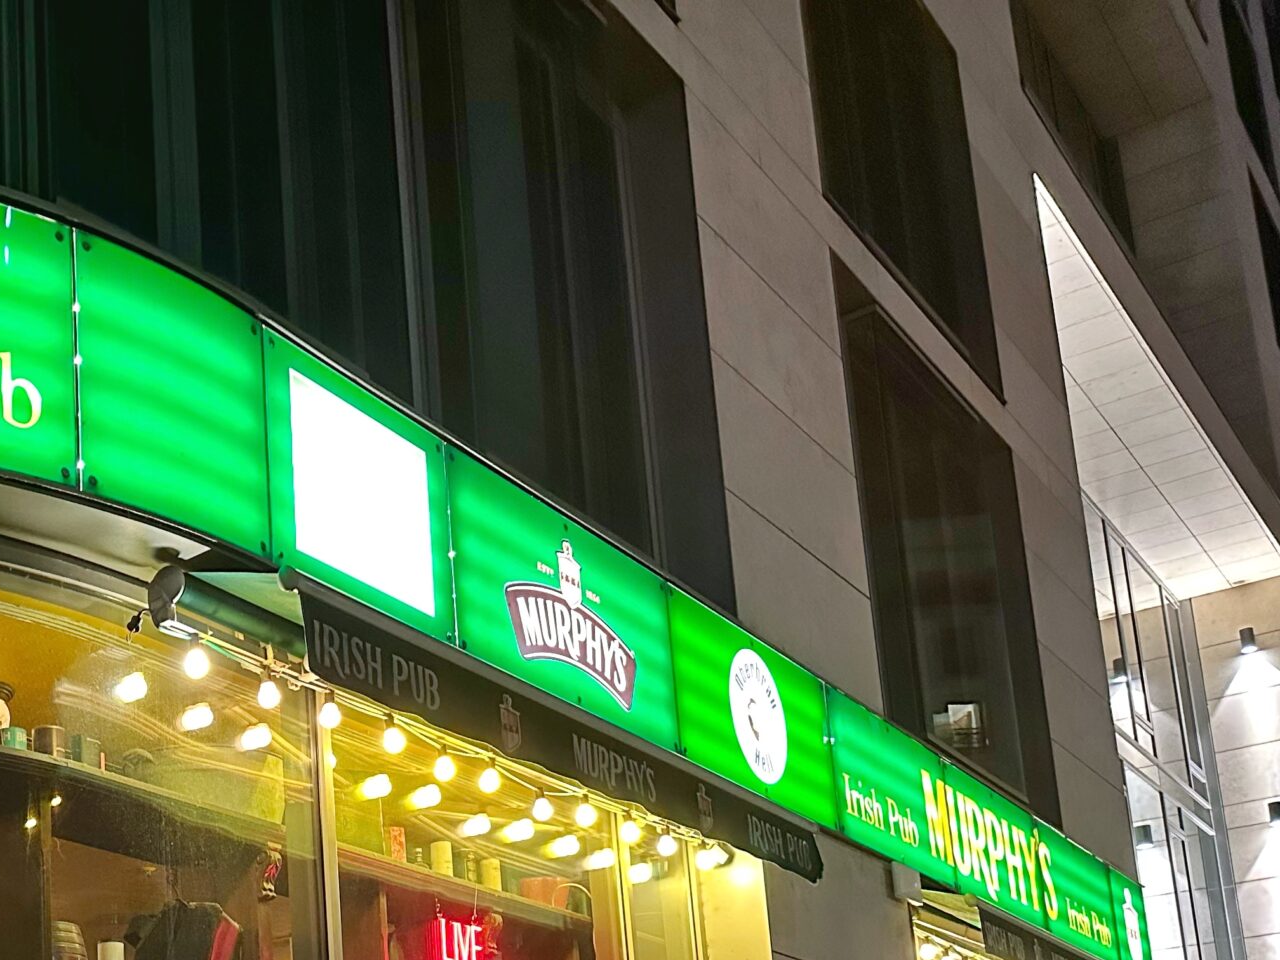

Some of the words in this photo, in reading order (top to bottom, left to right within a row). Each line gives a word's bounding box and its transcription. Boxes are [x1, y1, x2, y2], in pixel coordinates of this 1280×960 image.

[516, 596, 627, 693] MURPHY'S
[313, 619, 384, 690] IRISH
[392, 653, 441, 711] PUB
[572, 733, 657, 802] MURPHY'S
[747, 813, 785, 860] IRISH
[786, 832, 813, 871] PUB
[754, 747, 775, 774] Hell
[842, 772, 885, 832] Irish
[885, 796, 920, 848] Pub
[920, 768, 1059, 921] MURPHY'S
[1065, 896, 1093, 939] Irish
[1090, 910, 1112, 949] Pub
